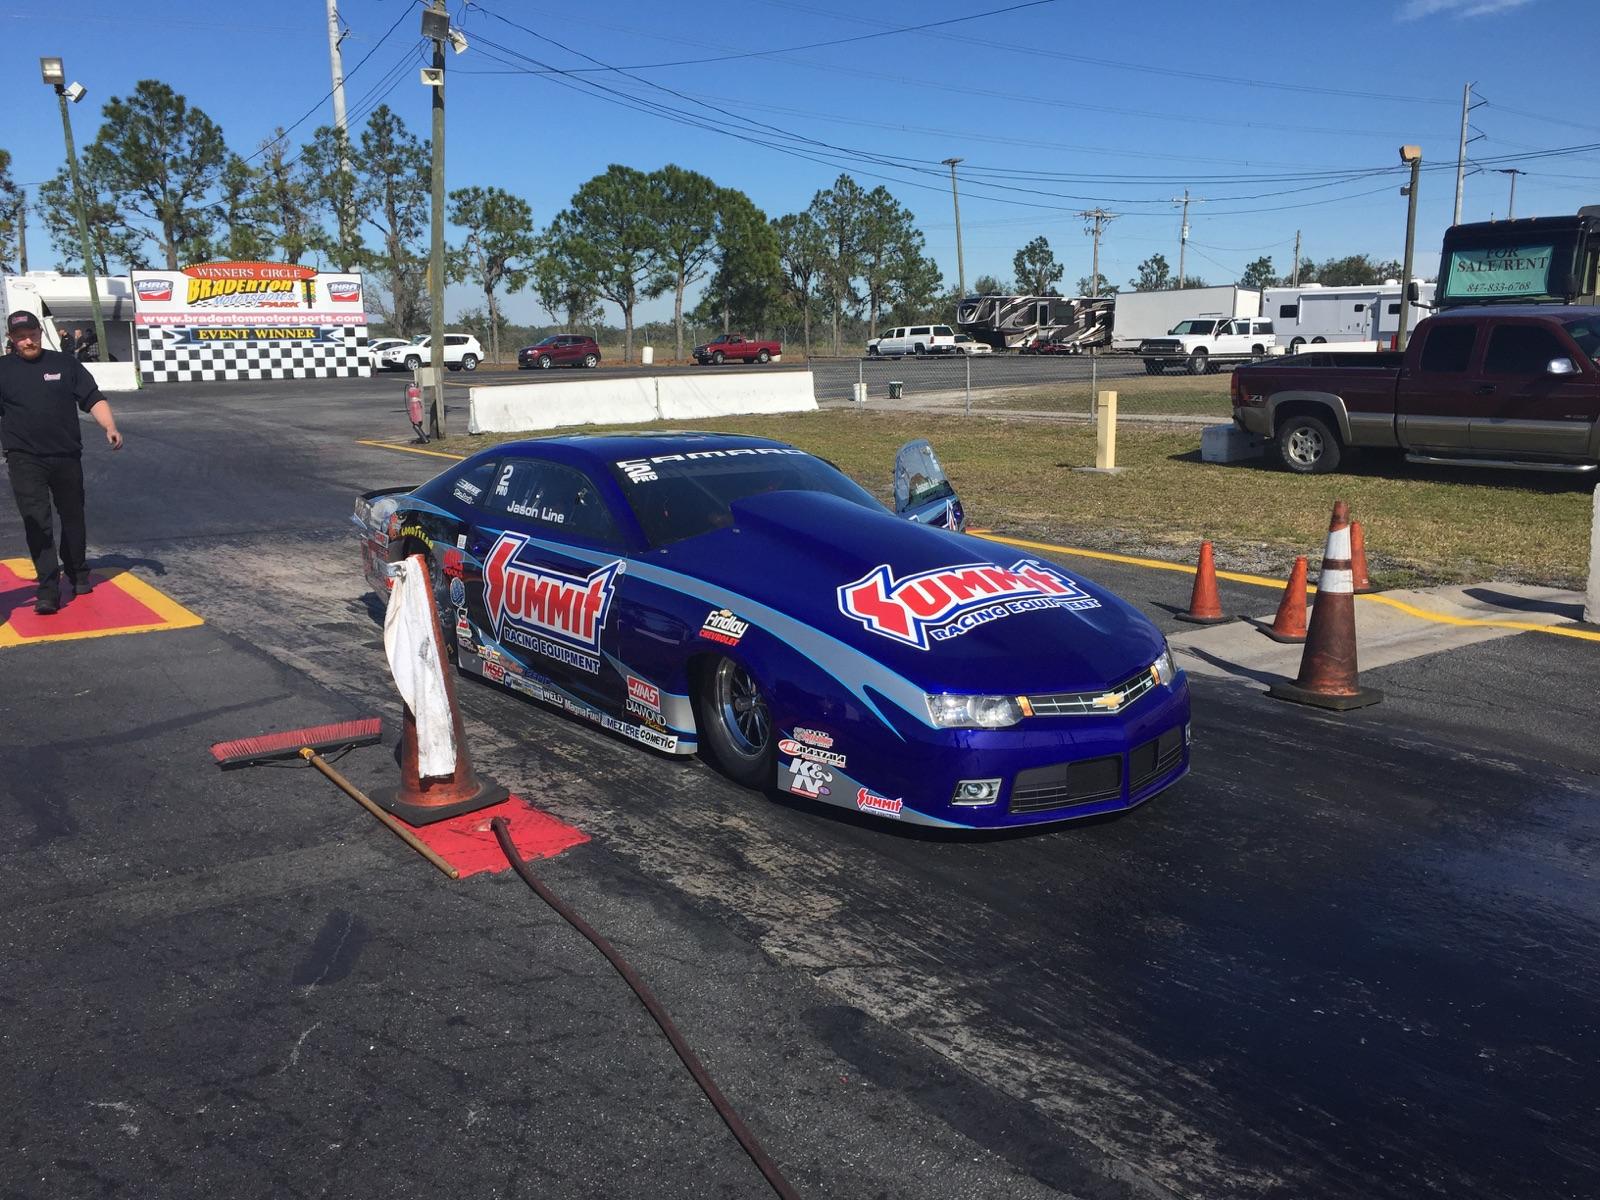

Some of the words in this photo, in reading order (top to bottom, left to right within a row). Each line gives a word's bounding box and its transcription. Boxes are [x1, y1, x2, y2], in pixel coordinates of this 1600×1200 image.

[1486, 248, 1519, 259] FOR
[197, 267, 254, 278] WINNERS
[260, 268, 301, 279] CIRCLE
[1457, 256, 1549, 273] SALE/RENT
[138, 281, 171, 290] IHRA
[186, 278, 294, 305] BRADENTON
[142, 313, 364, 324] www.bradentonmotorsports.com
[198, 328, 250, 340] EVENT
[254, 327, 316, 339] WINNER
[499, 464, 514, 487] 2
[632, 474, 659, 484] PRO
[495, 485, 508, 497] PRO
[506, 500, 539, 518] Jason
[541, 506, 565, 524] Line
[401, 525, 434, 550] GOODYEAR
[704, 610, 749, 638] Findlay
[929, 605, 1010, 641] RACING
[699, 629, 740, 647] CHEVROLET
[503, 626, 541, 654] RACING
[539, 640, 601, 675] EQUIPMENT
[543, 690, 563, 704] WELD
[629, 681, 659, 703] HAAS
[626, 699, 667, 727] DIAMOND
[607, 718, 640, 739] MEZIERE
